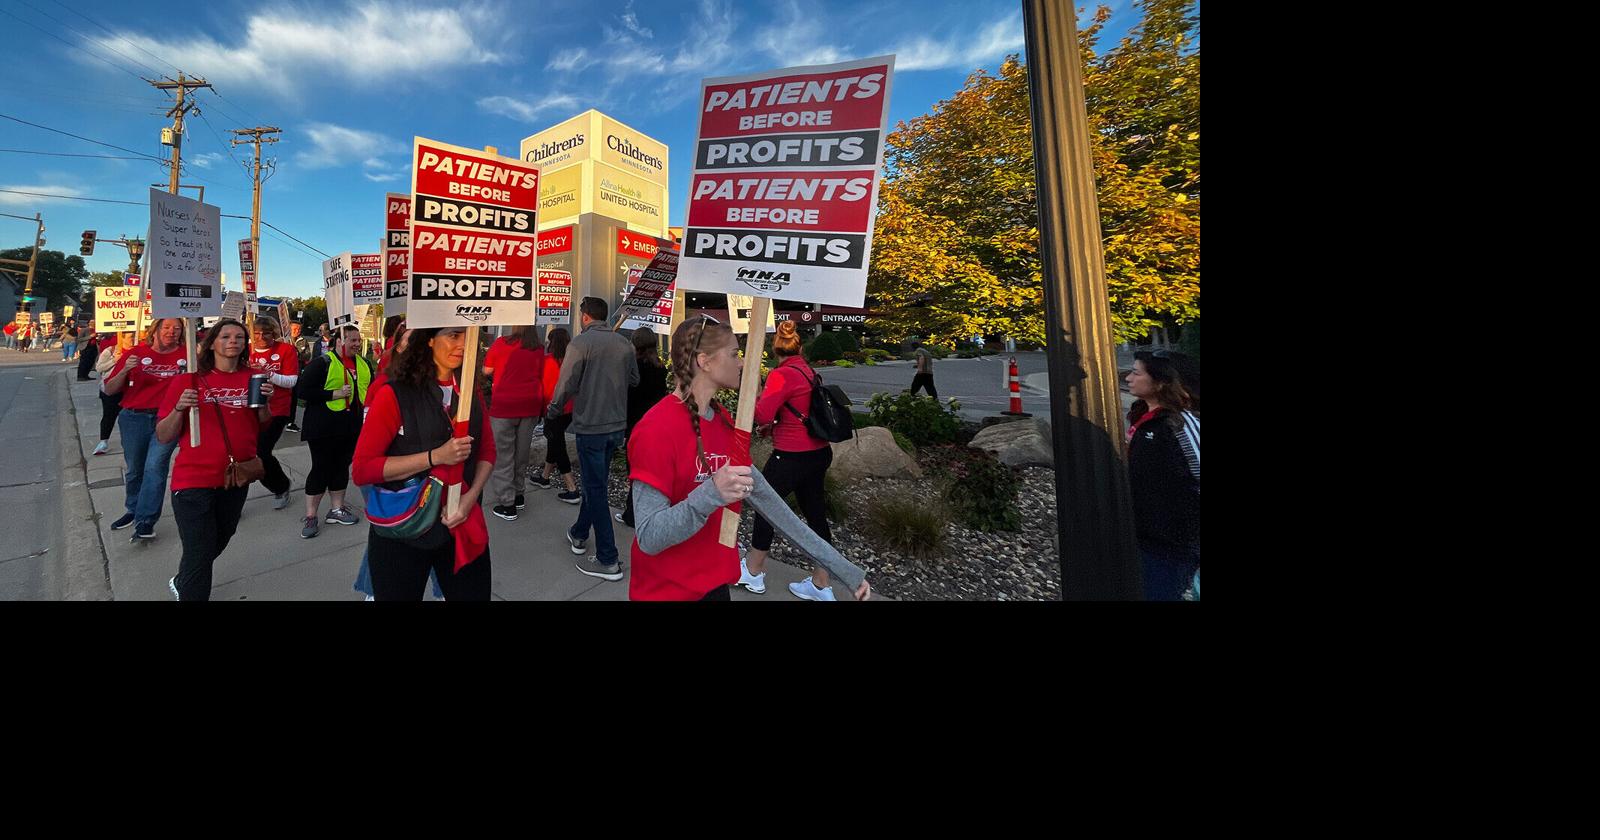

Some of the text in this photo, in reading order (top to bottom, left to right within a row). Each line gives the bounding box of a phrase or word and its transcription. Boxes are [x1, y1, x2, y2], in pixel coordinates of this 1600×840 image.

[704, 72, 885, 113] PATIENTS
[738, 109, 833, 131] BEFORE
[526, 134, 584, 162] Children's
[607, 134, 663, 170] Children's
[706, 136, 865, 165] PROFITS
[540, 153, 571, 168] INNESOTA
[621, 157, 653, 174] MINNESOTA
[420, 152, 537, 189] PATIENTS
[448, 181, 511, 202] BEFORE
[693, 177, 873, 202] PATIENTS
[542, 193, 575, 208] HOSPITAL
[600, 190, 659, 216] UNITED HOSPITAL
[157, 201, 190, 221] Nurses
[424, 200, 529, 230] PROFITS
[726, 207, 820, 225] BEFORE
[163, 220, 188, 236] Super
[415, 232, 533, 257] PATIENTS
[694, 232, 851, 264] PROFITS
[181, 251, 196, 259] and
[330, 257, 341, 272] SAFE
[444, 257, 507, 272] BEFORE
[540, 260, 564, 269] Hospital
[539, 272, 571, 280] PATIENTS
[643, 270, 675, 281] PROFITS
[105, 288, 134, 297] Don't
[179, 288, 202, 297] STRIKE
[420, 278, 526, 298] PROFITS
[625, 297, 655, 307] ROFITS
[112, 310, 125, 319] US
